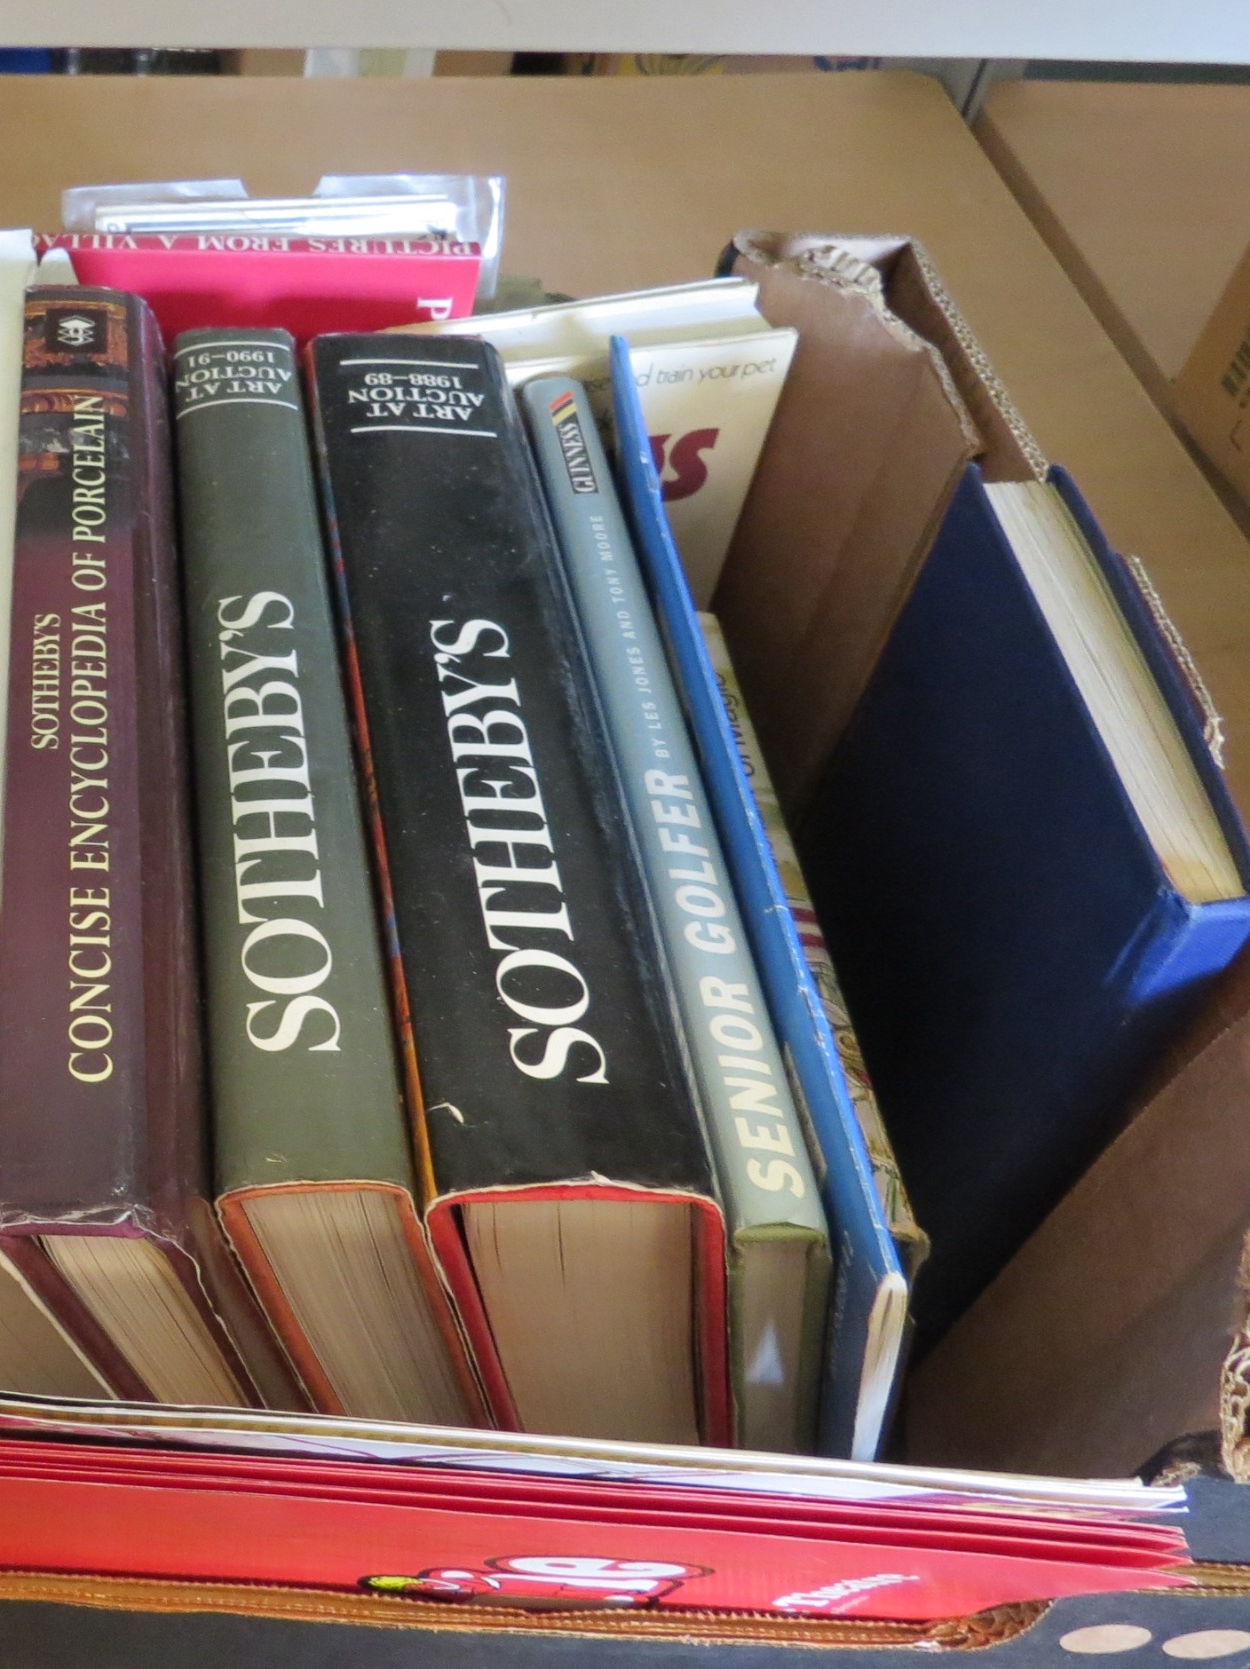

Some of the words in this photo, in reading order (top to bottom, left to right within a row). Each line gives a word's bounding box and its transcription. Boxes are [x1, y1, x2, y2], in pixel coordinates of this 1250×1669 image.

[157, 233, 180, 251] A
[197, 234, 290, 254] FROM
[308, 237, 473, 257] PICTURES
[187, 350, 276, 369] 1990-91
[655, 367, 694, 385] train
[698, 363, 741, 385] your
[740, 357, 778, 380] pet
[174, 365, 293, 395] AUCTION
[185, 380, 220, 403] AT
[226, 379, 283, 395] ART
[363, 372, 462, 389] 1988-89
[347, 388, 486, 408] AUCTION
[366, 402, 407, 419] AT
[413, 403, 474, 422] ART
[71, 394, 107, 544] PORCELAIN
[559, 422, 596, 493] GUINNESS
[589, 515, 615, 563] MOORE
[71, 551, 108, 592] OF
[604, 568, 626, 605] TONY
[617, 609, 637, 640] AND
[31, 612, 62, 750] SOTHEBY'S
[627, 645, 653, 694] JONES
[640, 701, 662, 730] LES
[69, 601, 110, 872] ENCYCLOPEDIA
[653, 736, 671, 758] BY
[217, 590, 342, 1053] SOTHEBY'S
[430, 617, 610, 1085] SOTHEBY'S
[644, 768, 736, 955] GOLFER
[68, 887, 113, 1083] CONCISE
[698, 974, 805, 1198] SENIOR
